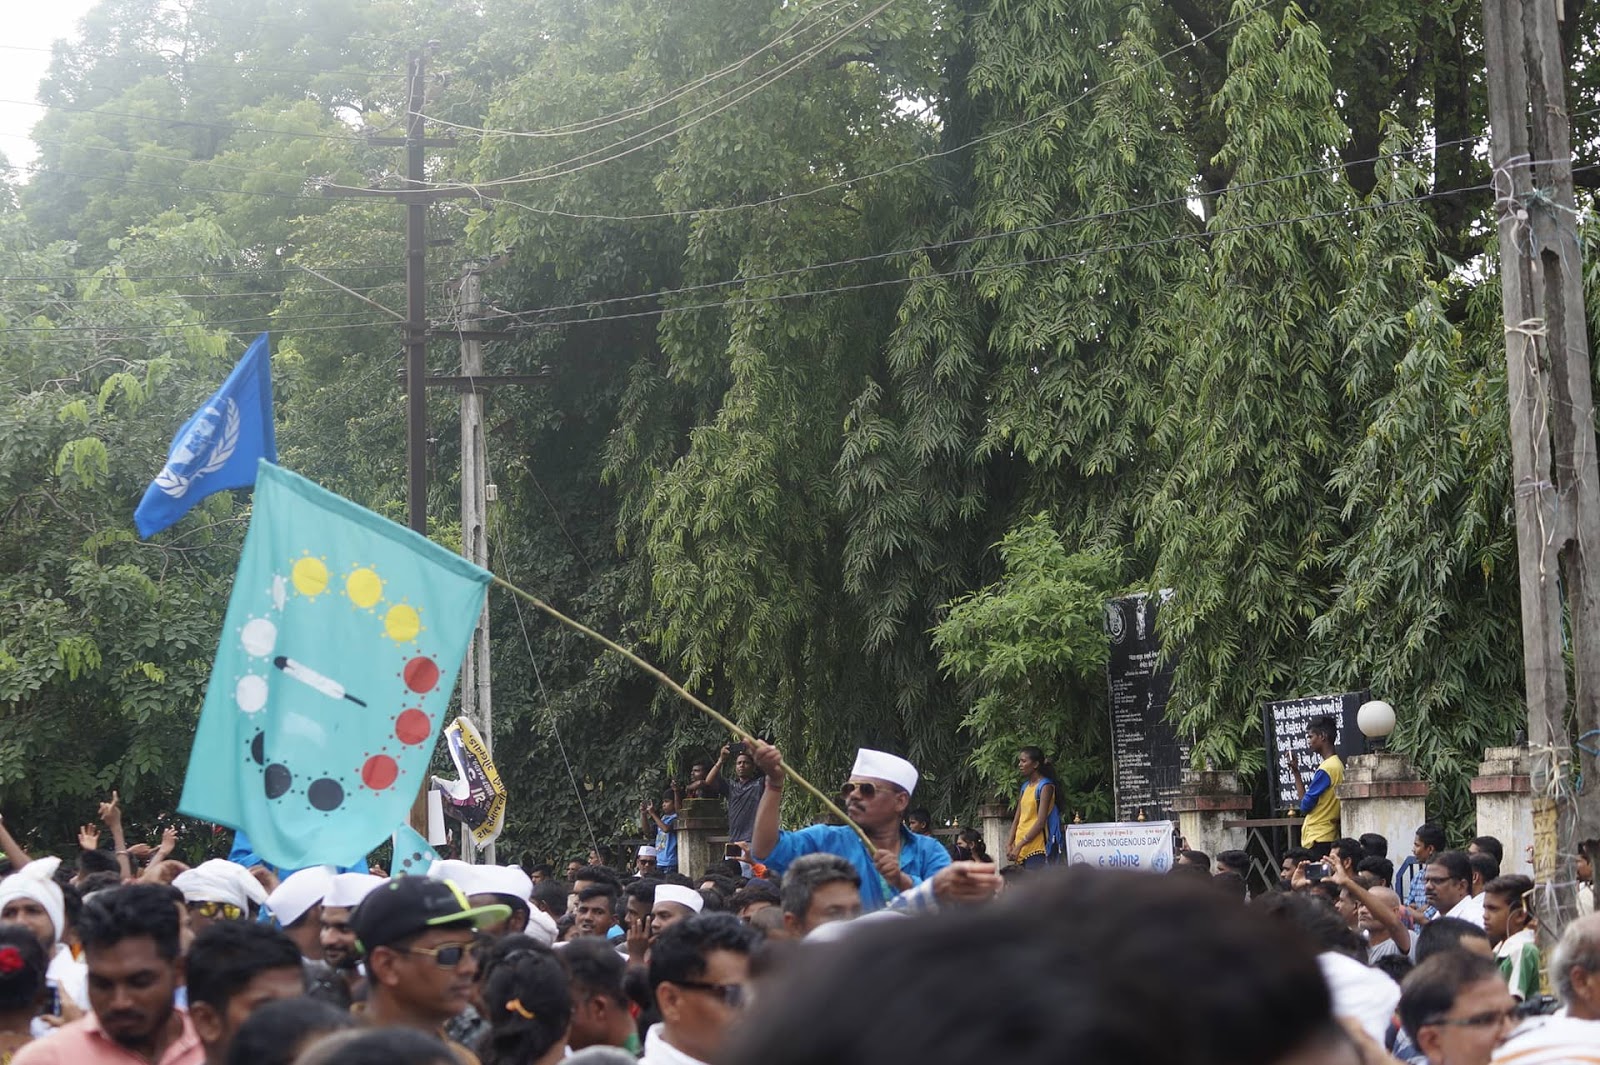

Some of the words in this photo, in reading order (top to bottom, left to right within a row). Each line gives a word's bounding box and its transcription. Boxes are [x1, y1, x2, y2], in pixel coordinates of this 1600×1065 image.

[1077, 838, 1106, 848] WORLD'S
[1107, 837, 1146, 847] INDIGENOUS
[1147, 836, 1161, 846] DAY
